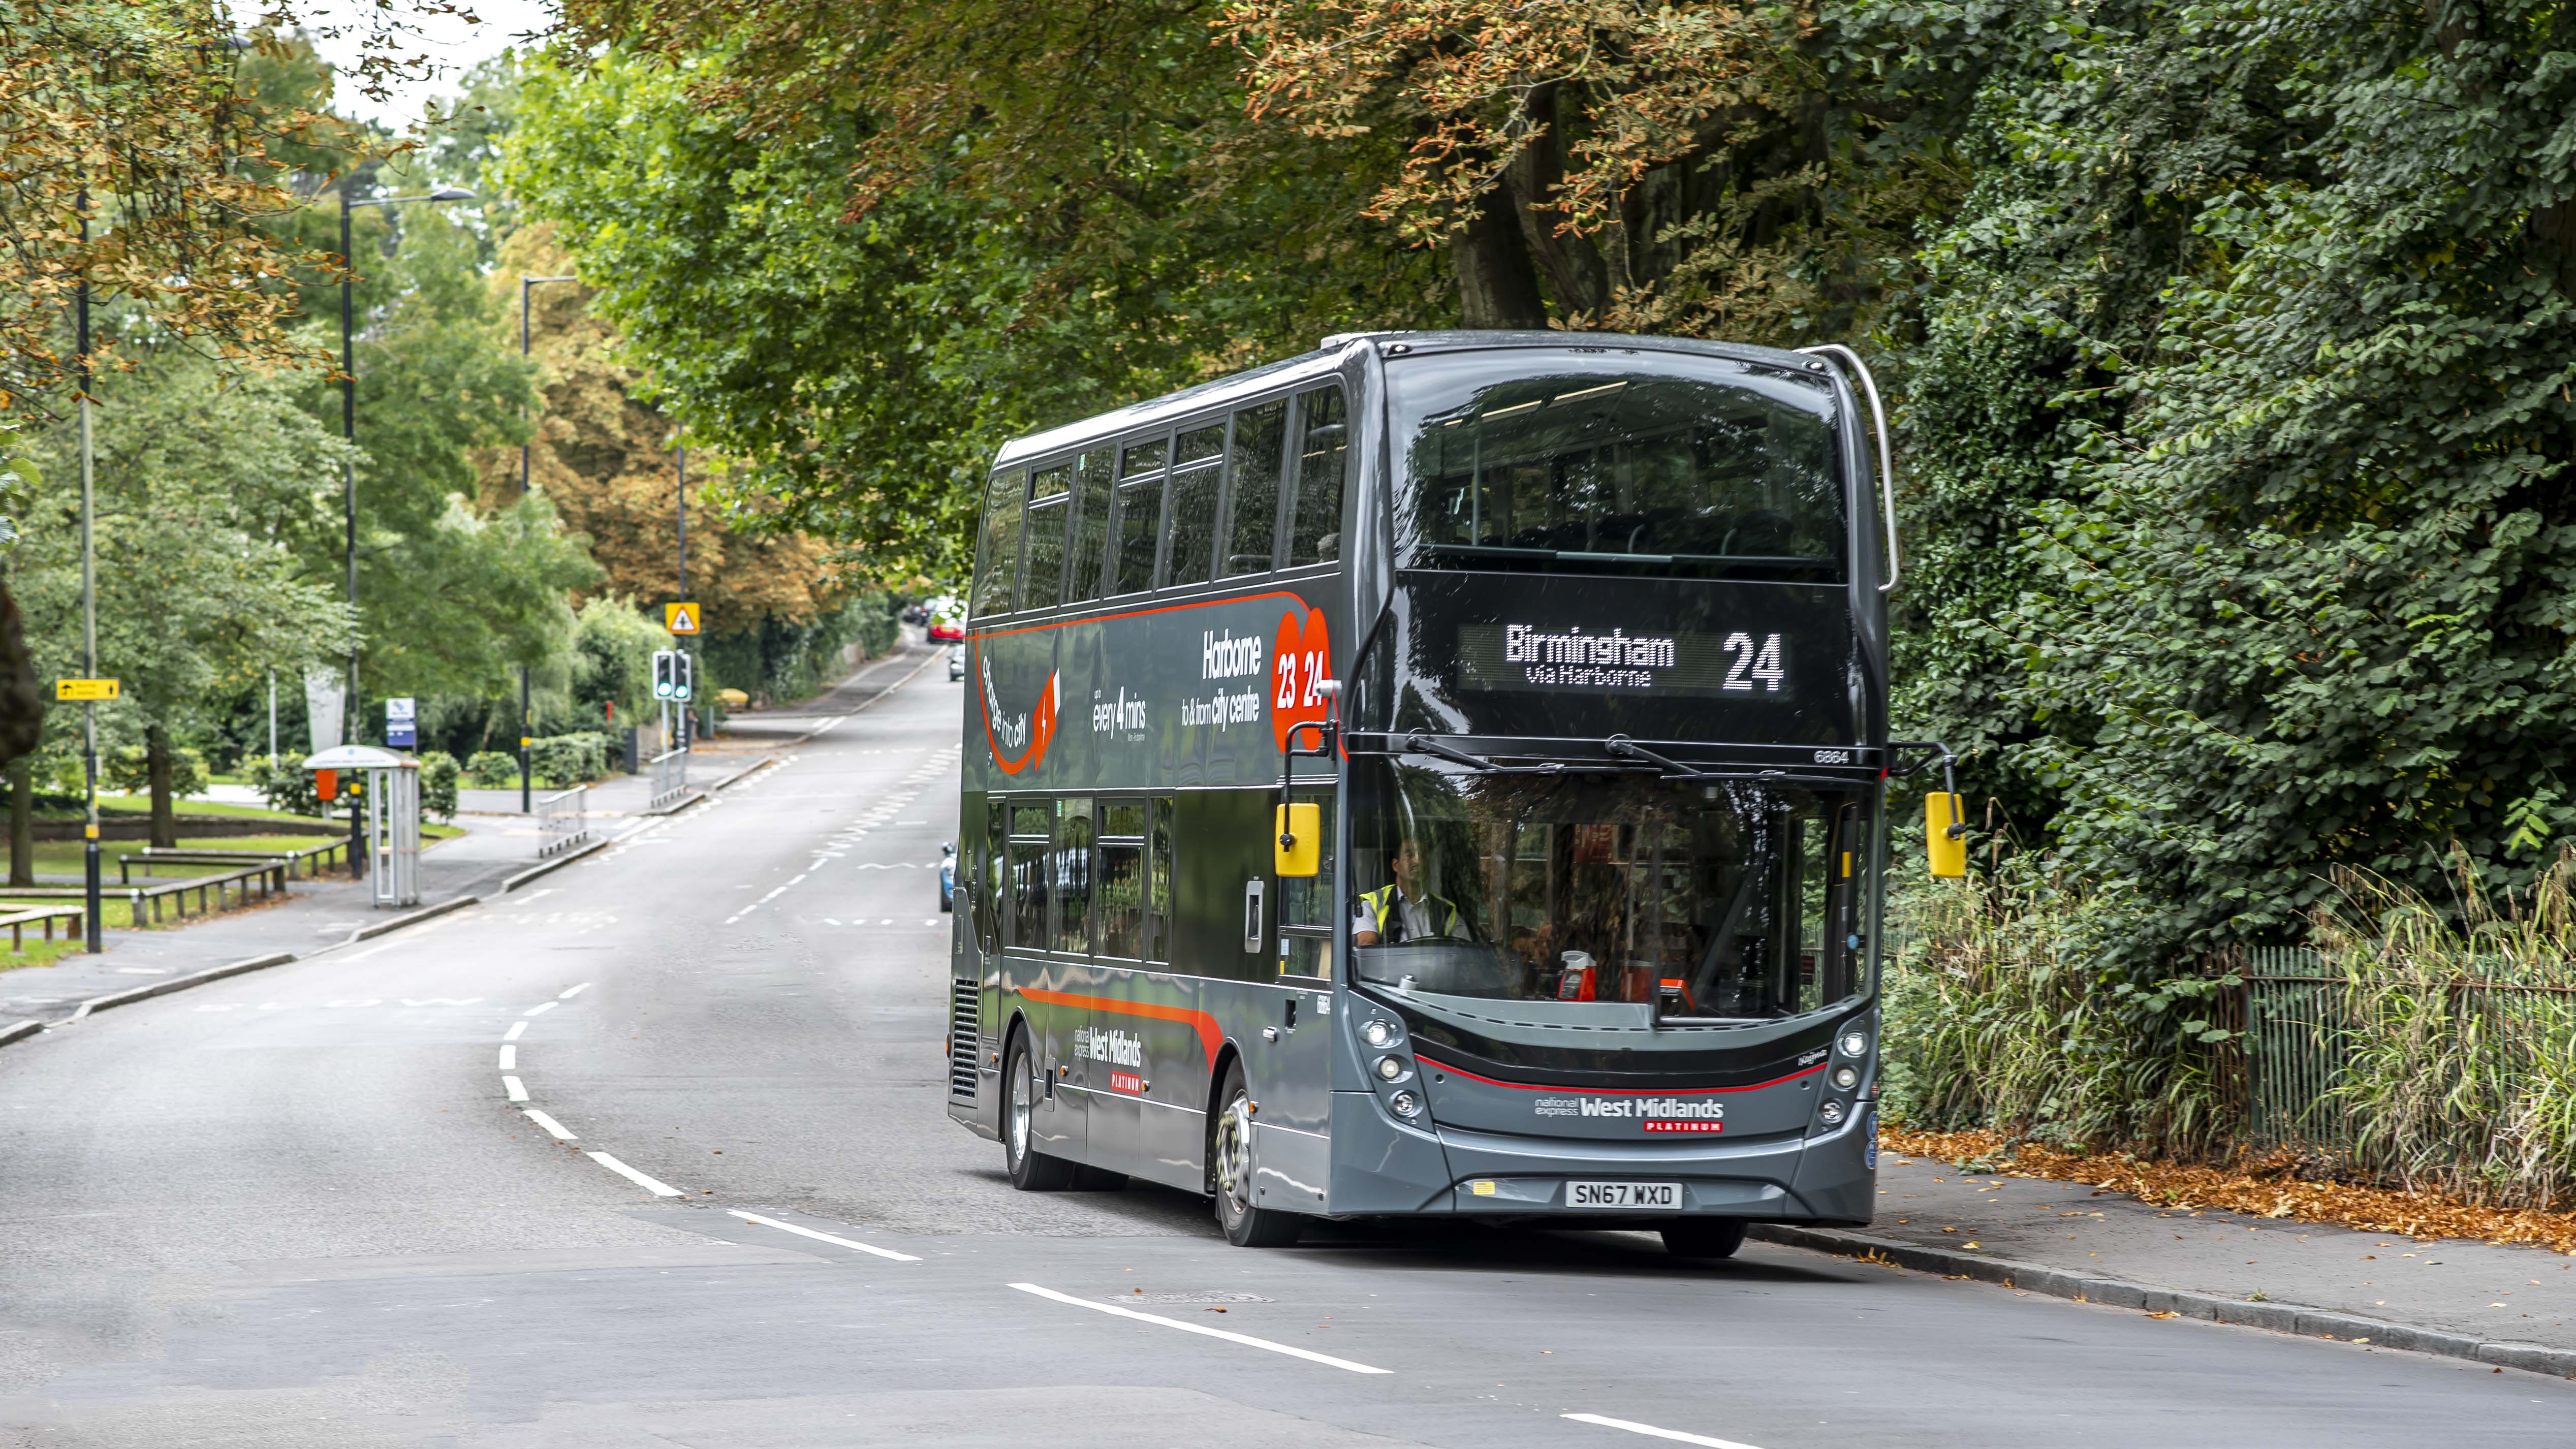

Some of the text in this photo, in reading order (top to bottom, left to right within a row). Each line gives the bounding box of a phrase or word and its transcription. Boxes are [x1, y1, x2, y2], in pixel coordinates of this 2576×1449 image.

[1203, 628, 1262, 679] Harborne
[1506, 624, 1675, 667] Birmingham
[1723, 632, 1784, 690] 24
[1277, 652, 1296, 709] 23
[1303, 650, 1324, 707] 24
[1559, 666, 1651, 686] Harborne
[983, 655, 1026, 748] charge into city
[1182, 685, 1260, 732] to & from city centre
[1093, 686, 1146, 739] every 4 mins
[1814, 750, 1849, 764] 6864
[1074, 1025, 1090, 1044] national
[1074, 1044, 1089, 1061] express
[1090, 1026, 1141, 1067] West Midlands
[1112, 1074, 1139, 1091] PLATINUM
[1535, 1097, 1579, 1107] national
[1535, 1107, 1579, 1118] express
[1580, 1097, 1724, 1118] West Midlands
[1646, 1122, 1720, 1131] PLATINUM
[1576, 1185, 1672, 1205] SN67 WXD
